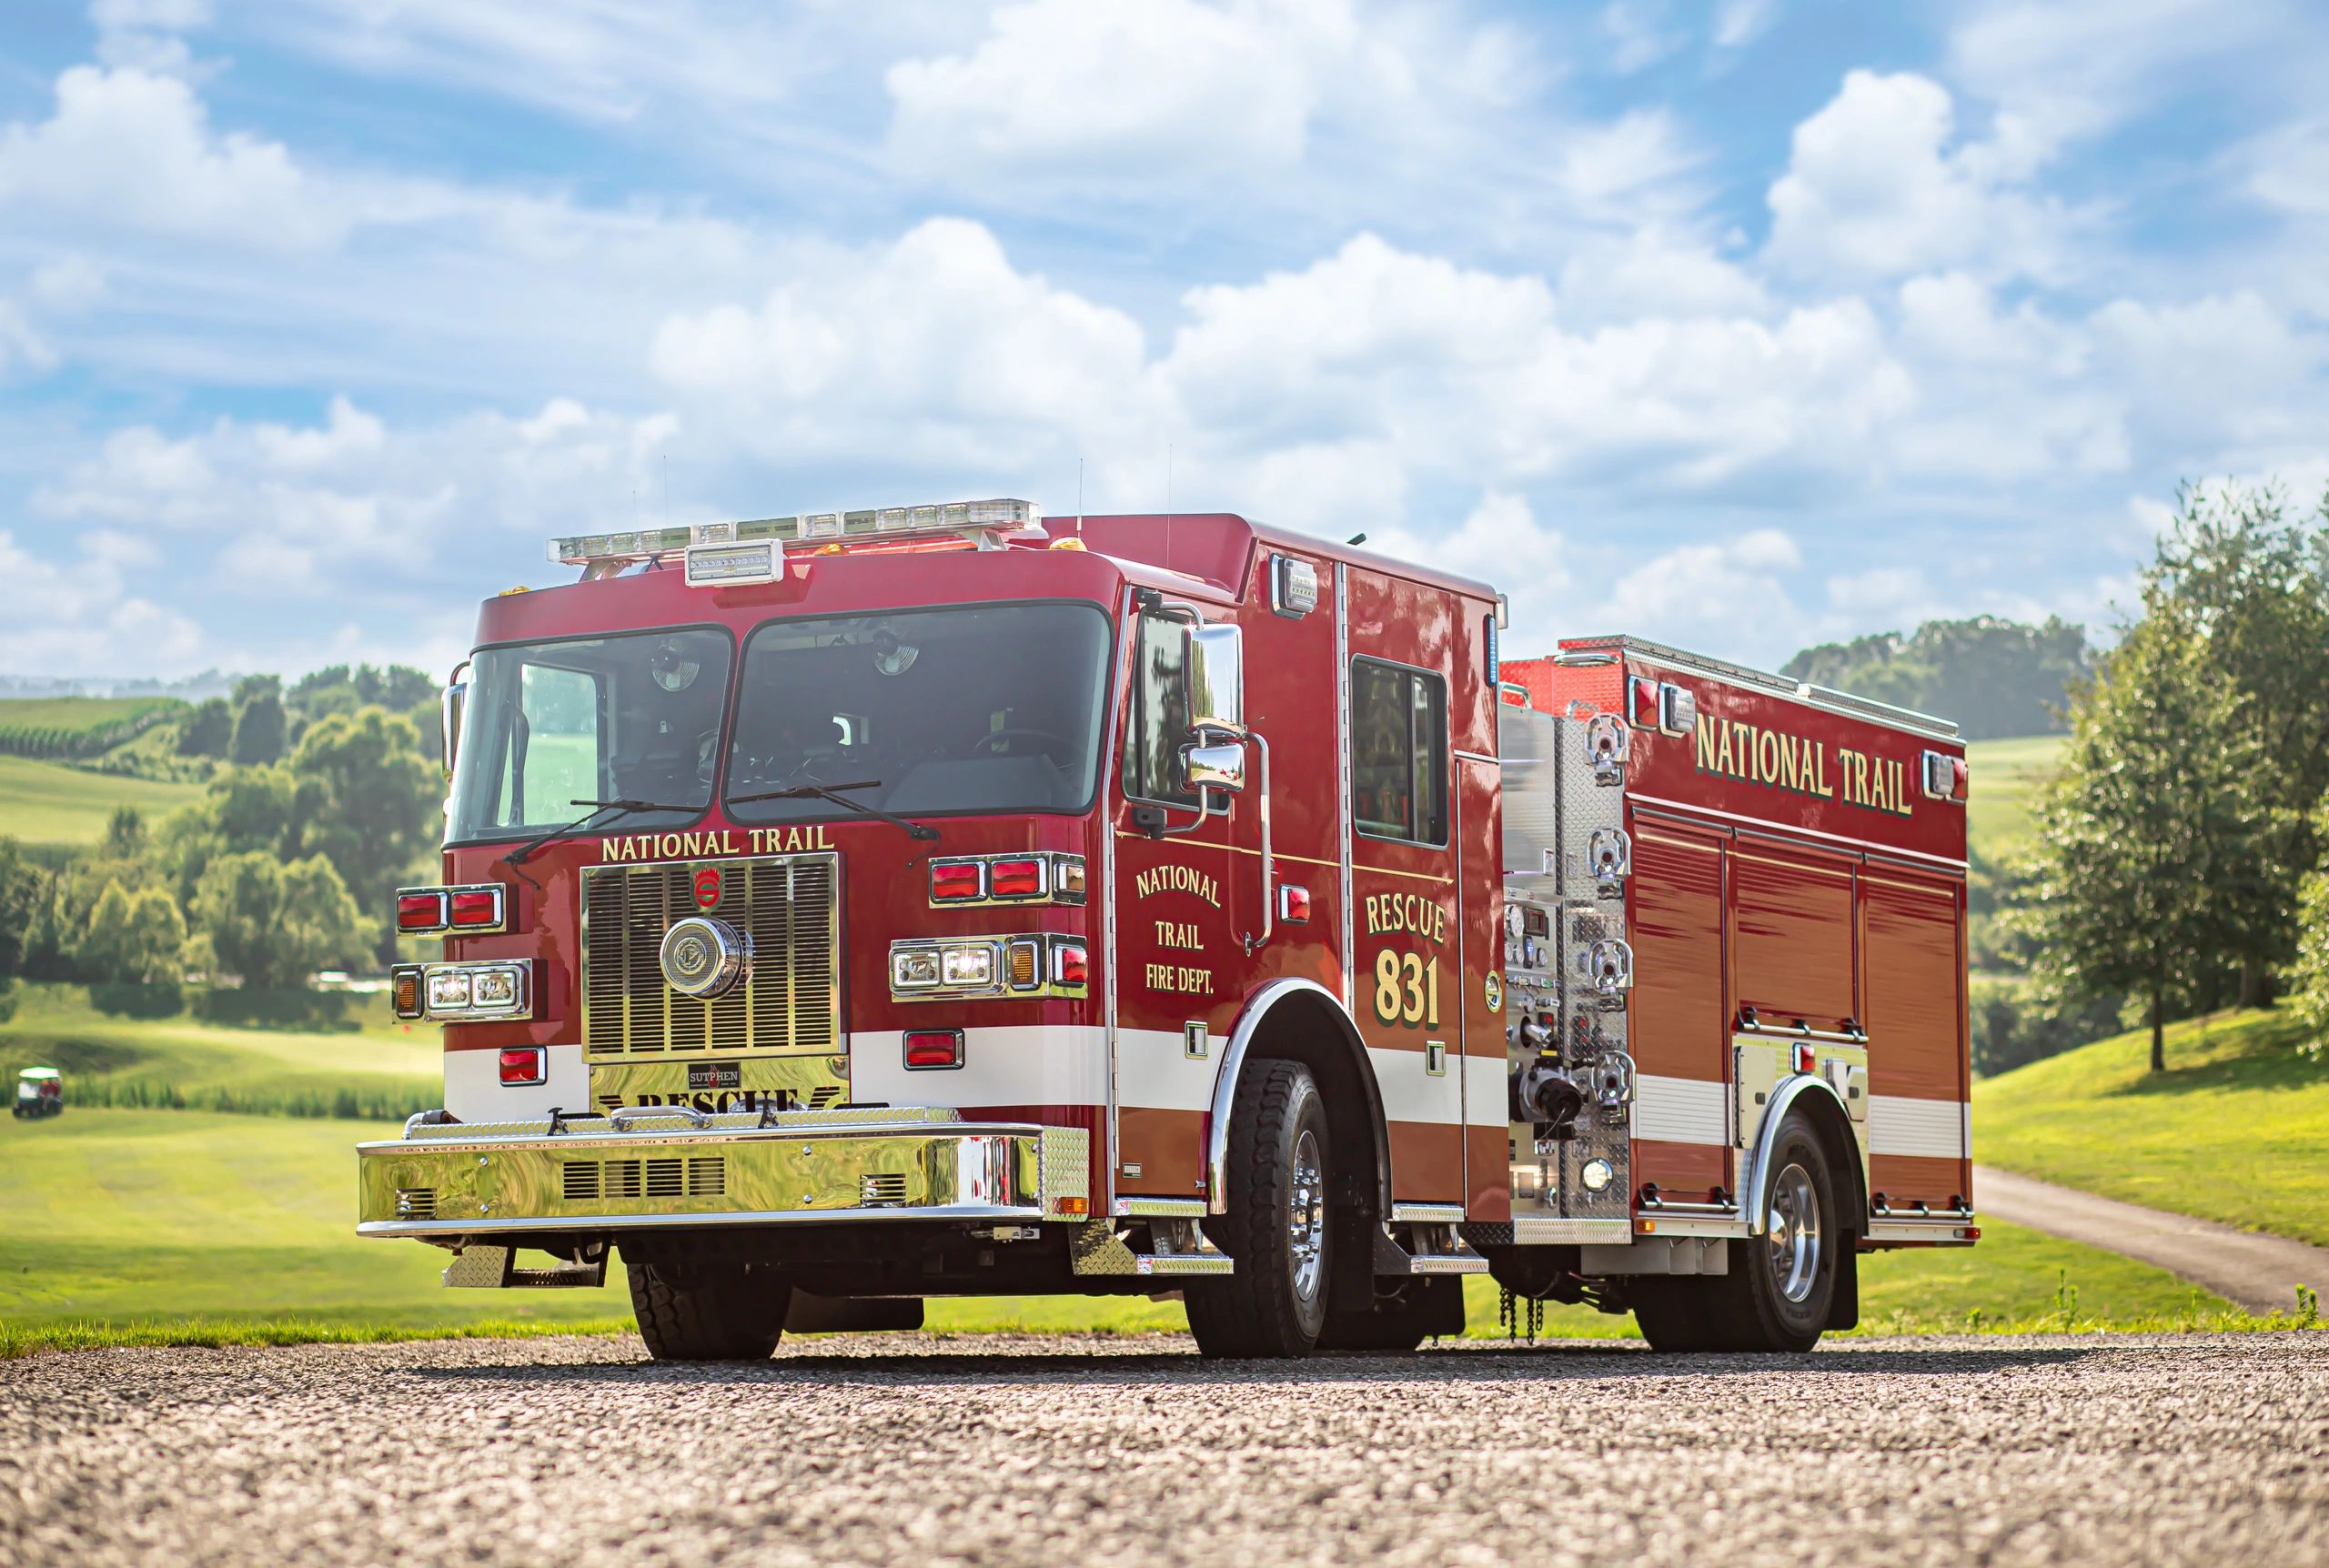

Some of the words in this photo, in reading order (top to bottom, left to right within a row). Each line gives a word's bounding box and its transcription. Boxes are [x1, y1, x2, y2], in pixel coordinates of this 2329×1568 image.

[1696, 712, 1834, 799] NATIONAL
[1839, 748, 1913, 816] TRAIL
[601, 829, 741, 863] NATIONAL
[748, 825, 836, 853] TRAIL
[1135, 865, 1221, 909] NATIONAL
[1154, 920, 1205, 950] TRAIL
[1366, 892, 1446, 944] RESCUE
[1145, 963, 1175, 991] FIRE
[1178, 967, 1215, 995] DEPT.
[1375, 948, 1439, 1030] 831
[690, 1070, 739, 1082] SUTPHEN
